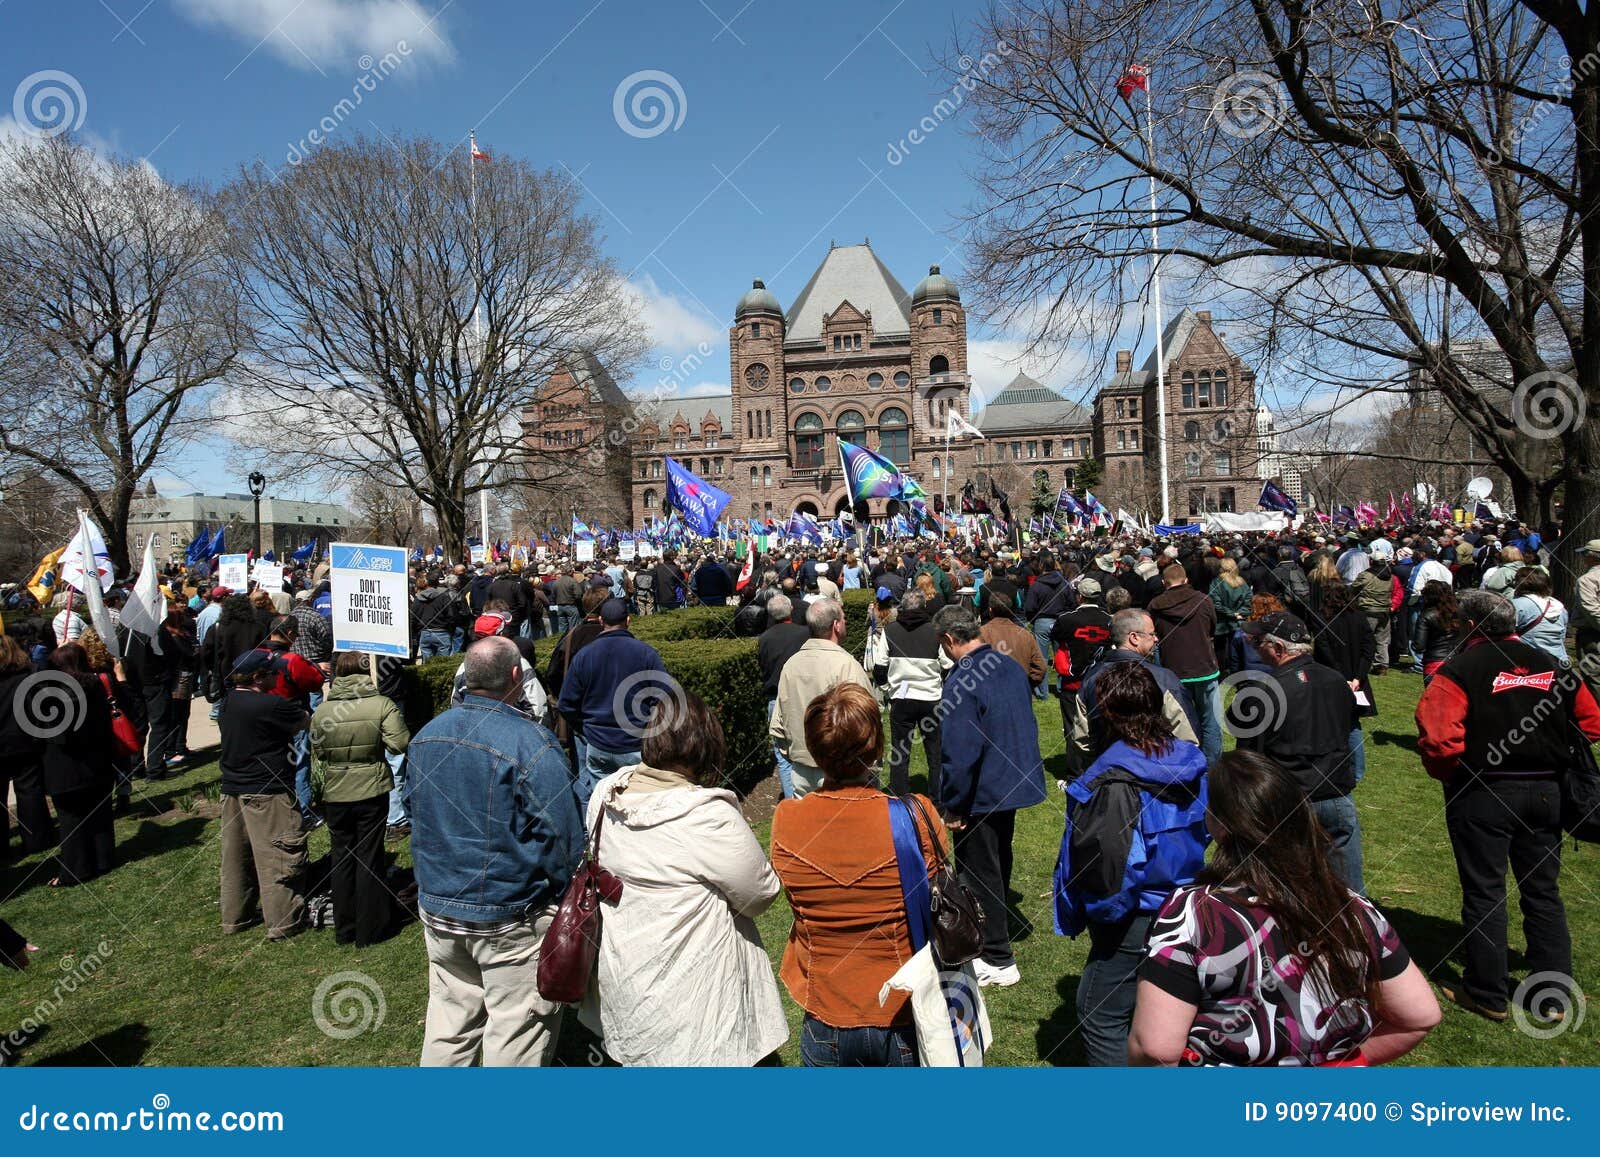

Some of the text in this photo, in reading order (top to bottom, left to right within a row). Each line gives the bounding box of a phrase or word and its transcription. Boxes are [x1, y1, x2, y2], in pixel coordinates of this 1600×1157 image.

[359, 578, 381, 594] DON'T
[350, 593, 391, 611] FORECLOSE
[348, 608, 394, 626] OUR FUTURE
[1493, 676, 1556, 686] Budweiser
